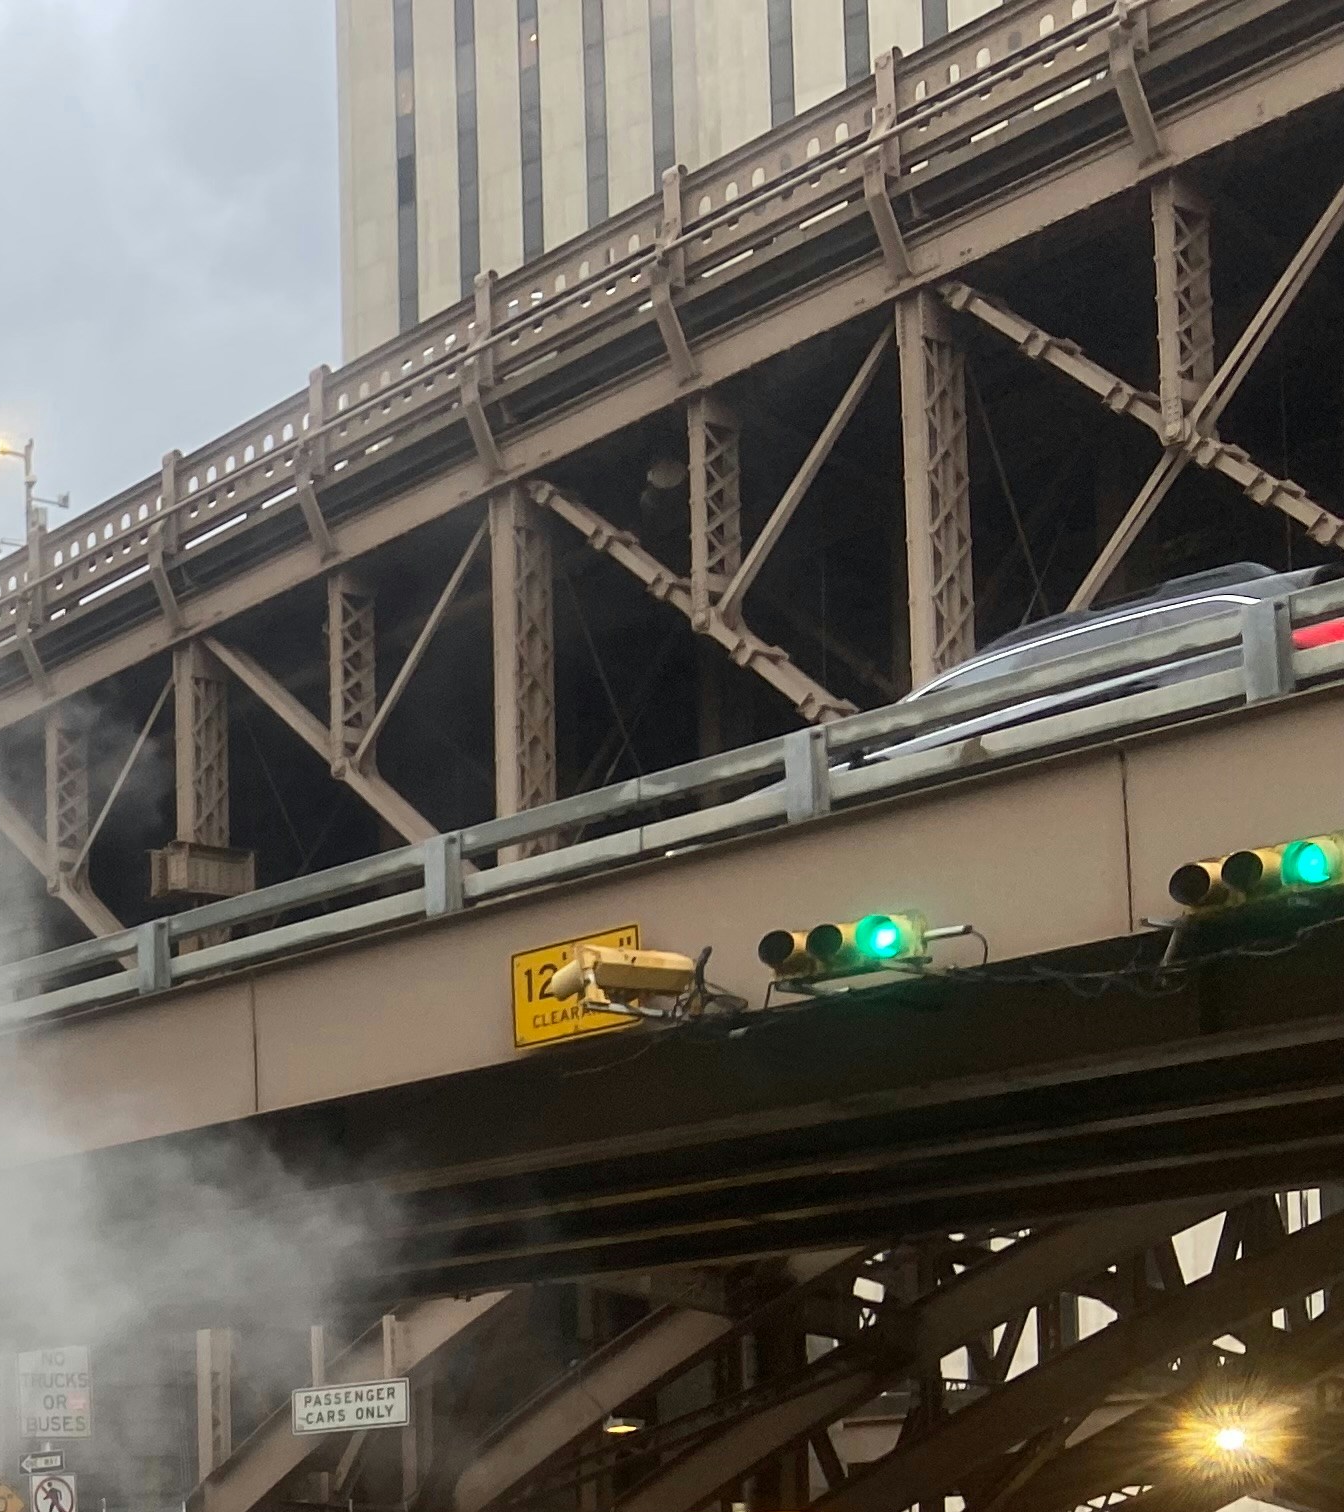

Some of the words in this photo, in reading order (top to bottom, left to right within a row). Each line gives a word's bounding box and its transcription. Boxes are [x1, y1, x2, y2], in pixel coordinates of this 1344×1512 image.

[21, 1372, 88, 1388] TRUCKS
[43, 1395, 67, 1410] OR
[304, 1387, 396, 1408] PASSENGER
[306, 1409, 346, 1424] CARS
[356, 1404, 394, 1420] ONLY
[26, 1416, 86, 1431] BUSES
